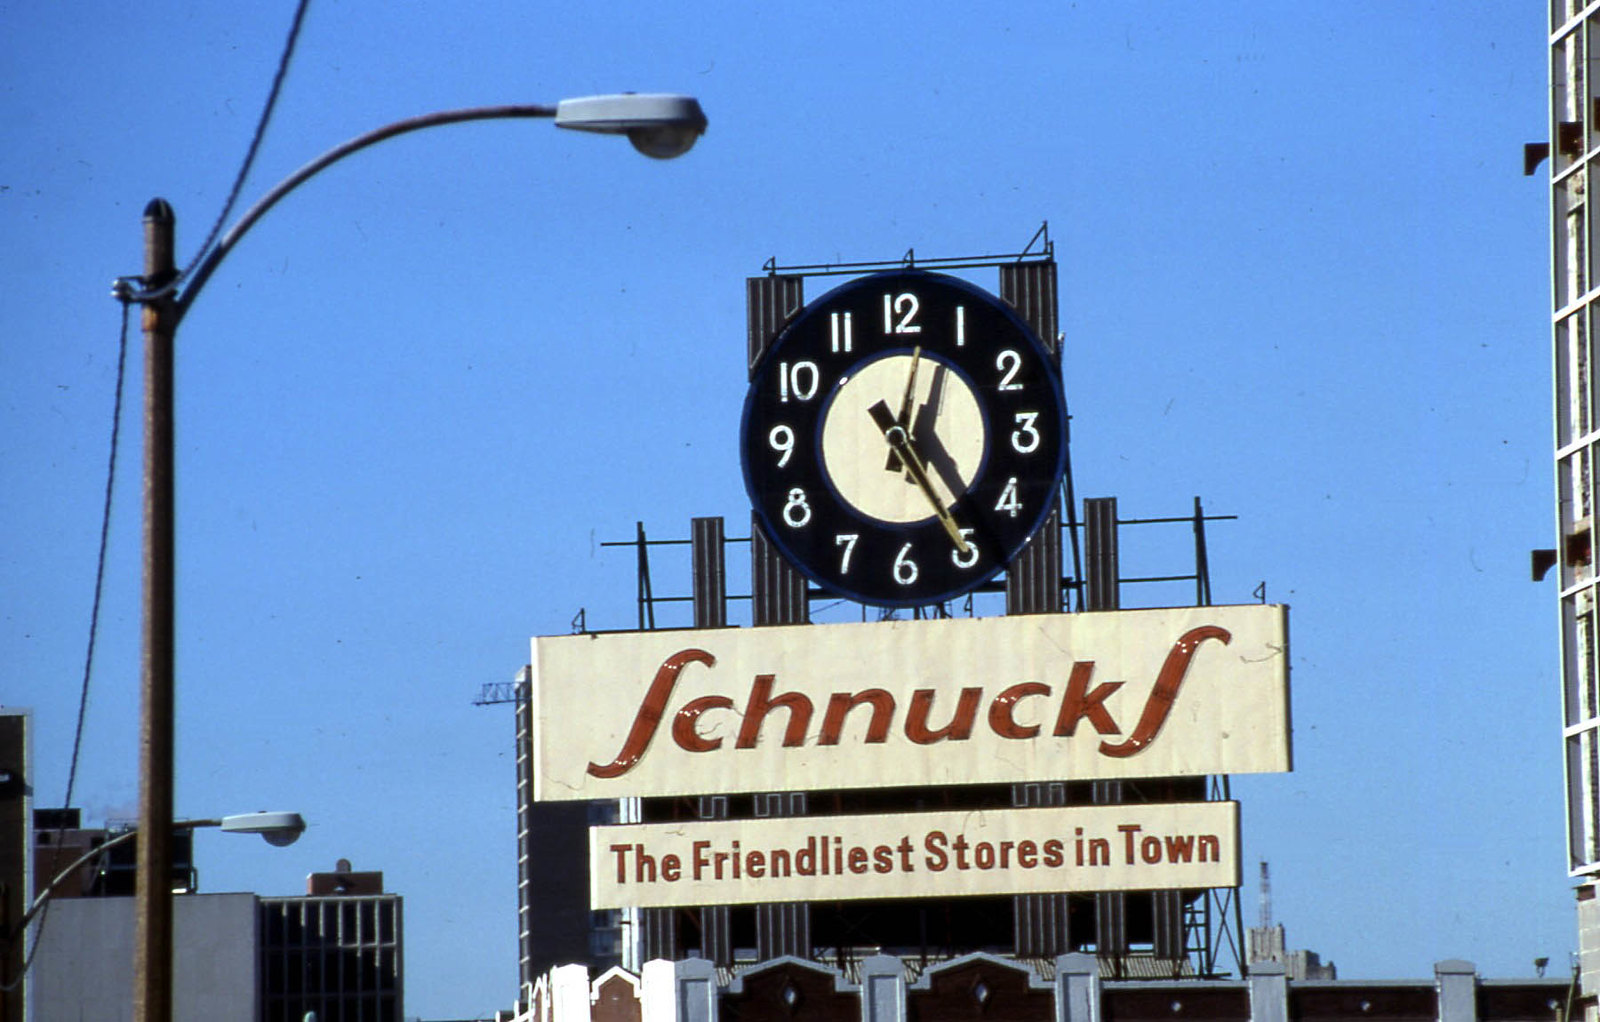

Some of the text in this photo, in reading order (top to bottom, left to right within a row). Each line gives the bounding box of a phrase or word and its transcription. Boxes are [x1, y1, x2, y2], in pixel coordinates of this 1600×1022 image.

[831, 313, 852, 352] 11
[884, 293, 921, 334] 12
[956, 306, 965, 347] 1
[780, 361, 819, 402] 10
[996, 350, 1023, 391] 2
[769, 425, 794, 467] 9
[1012, 412, 1040, 453] 3
[783, 488, 811, 527] 8
[995, 477, 1022, 517] 4
[836, 534, 858, 574] 7
[893, 543, 918, 584] 6
[952, 528, 979, 568] 5
[609, 825, 1220, 883] The Friendliest Stores in Town
